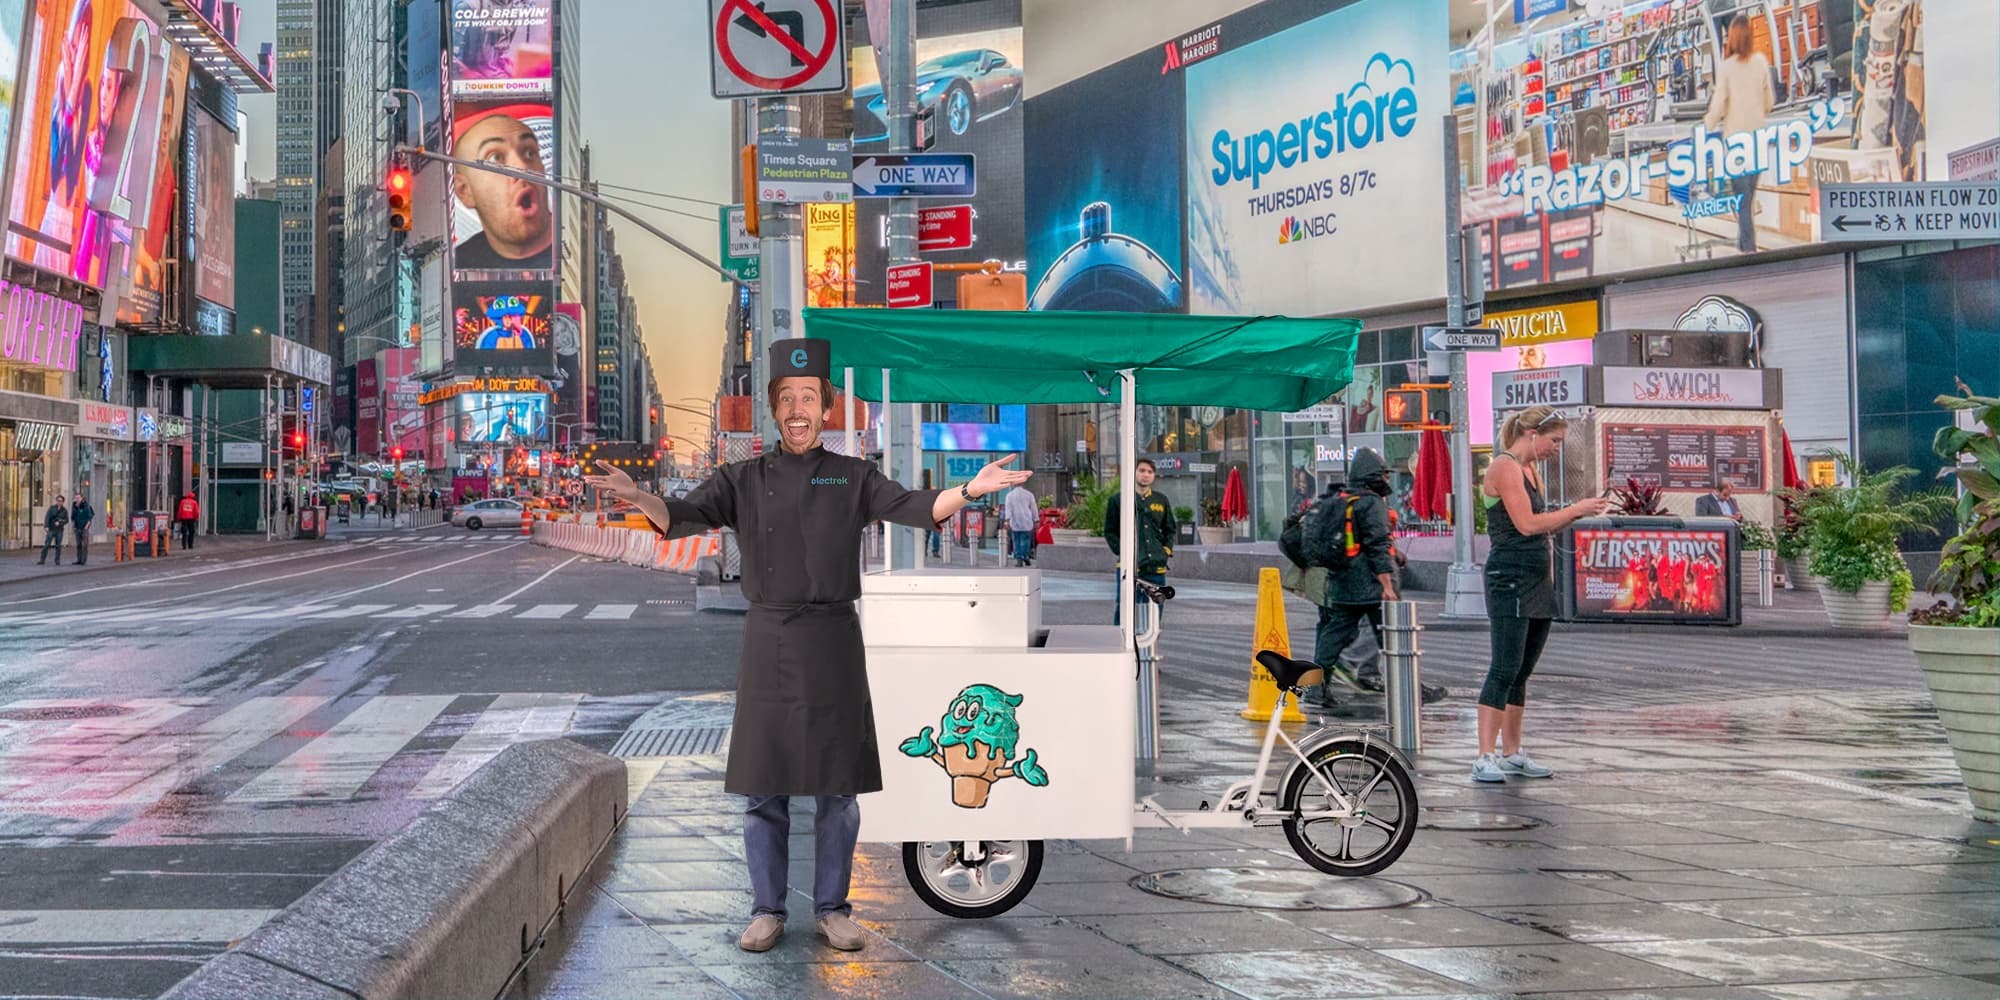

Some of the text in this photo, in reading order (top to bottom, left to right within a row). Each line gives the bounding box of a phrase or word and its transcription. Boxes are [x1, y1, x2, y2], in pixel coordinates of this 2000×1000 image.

[455, 7, 549, 19] COLD BREWIN'
[472, 19, 495, 27] WHAT
[1182, 24, 1222, 49] MARRIOTT
[1182, 40, 1217, 63] MARQUIS
[506, 82, 540, 90] DONUTS
[1211, 86, 1418, 190] Superstore
[763, 154, 838, 168] Times Square
[763, 167, 848, 180] Pedestrian Plaza
[879, 166, 960, 184] ONE WAY
[1248, 170, 1376, 217] THURSDAYS 8/7c
[1830, 188, 1997, 208] PEDESTRIAN FLOW ZO
[810, 207, 840, 224] KING
[925, 210, 957, 221] STANDING
[1915, 211, 1997, 230] KEEP MOVI
[919, 222, 941, 232] nytime
[1303, 213, 1337, 240] NBC
[731, 243, 749, 251] TURN
[744, 268, 758, 277] 45
[889, 268, 921, 280] NO STANDING
[889, 280, 911, 291] Anytime
[1487, 310, 1568, 339] INVICTA
[1447, 334, 1493, 345] ONE WAY
[790, 348, 808, 368] e
[489, 378, 510, 392] DOW
[1645, 371, 1721, 397] S'WICH
[1505, 380, 1569, 405] SHAKES
[15, 422, 57, 450] FOREVER
[1668, 453, 1708, 467] S'WICH
[811, 476, 849, 486] electrek
[1582, 539, 1723, 569] JERSEY BOYS
